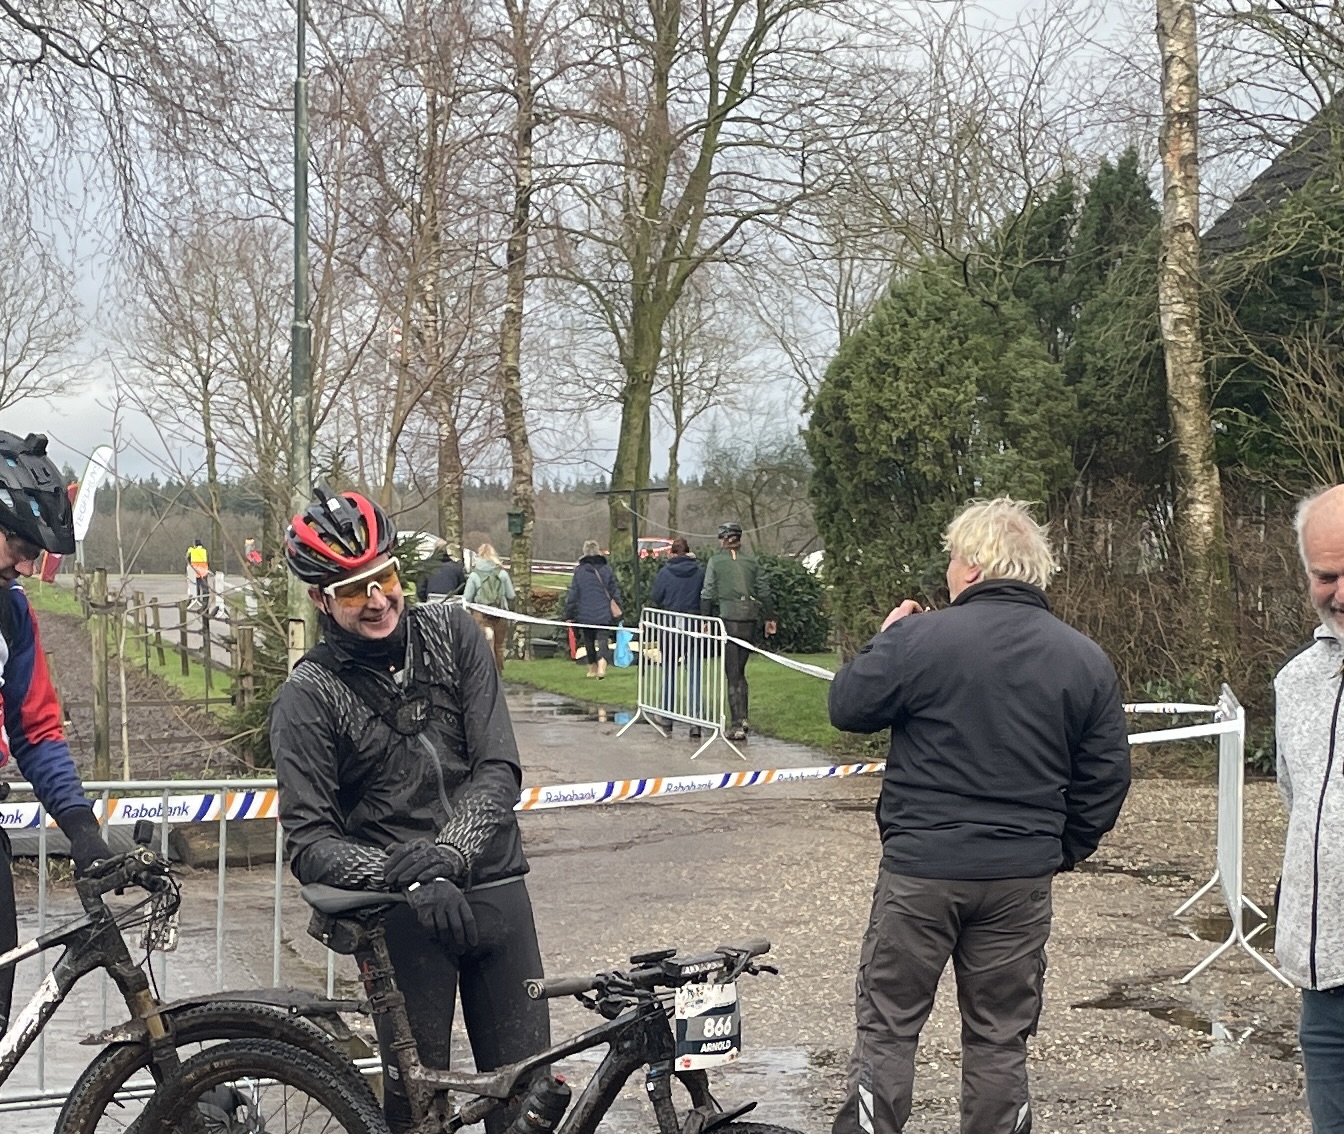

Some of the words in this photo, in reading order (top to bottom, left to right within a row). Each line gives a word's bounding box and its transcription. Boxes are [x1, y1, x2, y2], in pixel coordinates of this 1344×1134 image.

[545, 790, 598, 802] Rabobank
[121, 804, 190, 819] Rabobank
[703, 1016, 733, 1038] 866
[700, 1040, 732, 1053] ARNOLD
